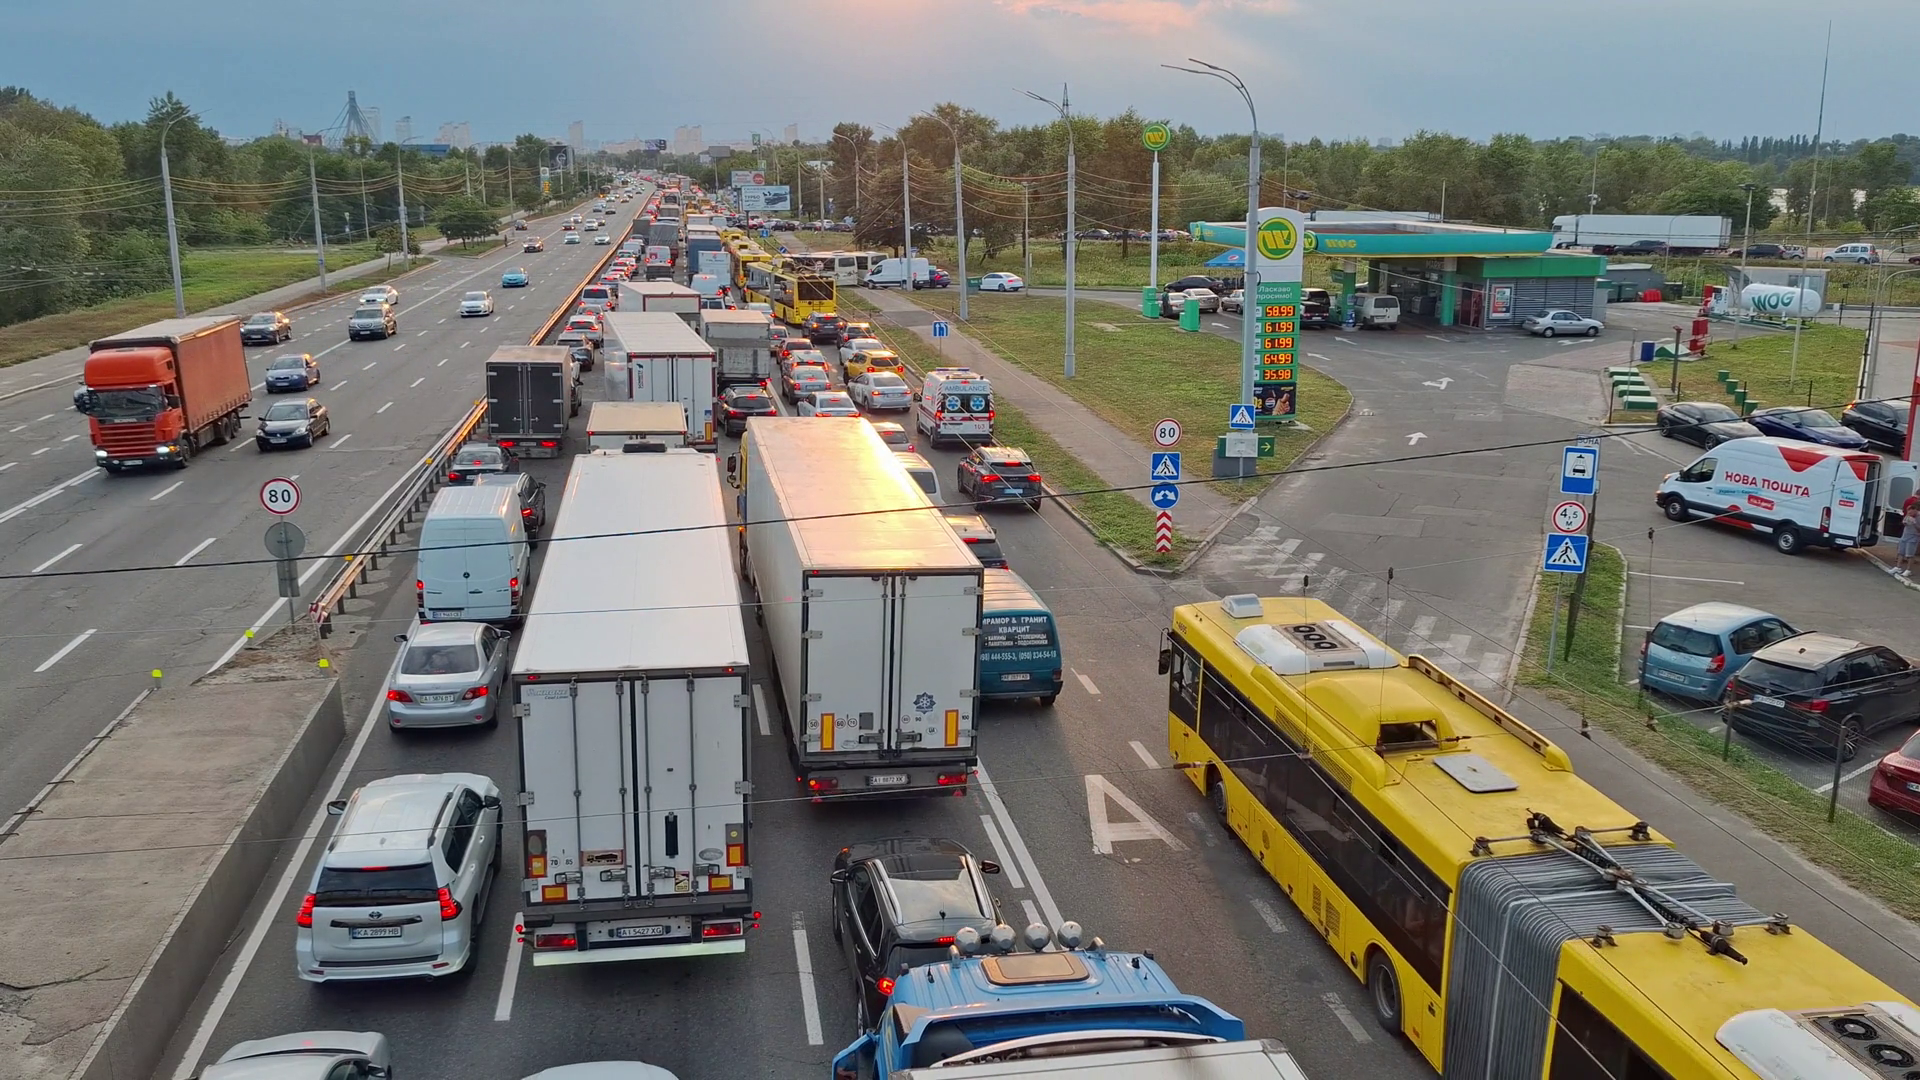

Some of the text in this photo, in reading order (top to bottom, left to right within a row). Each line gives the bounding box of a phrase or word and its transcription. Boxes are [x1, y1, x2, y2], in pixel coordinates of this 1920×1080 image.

[1751, 291, 1796, 311] WOG
[1266, 305, 1294, 317] 58.99
[1265, 322, 1293, 333] 61.99
[1265, 337, 1292, 349] 61.99
[1264, 353, 1292, 365] 64.99
[1264, 369, 1291, 380] 35.98
[1159, 427, 1176, 439] 80
[1725, 471, 1810, 498] НОВА ПОШТА
[268, 489, 291, 503] 80
[1560, 508, 1579, 520] 4,5
[1021, 616, 1048, 624] ГРАНИТ
[999, 626, 1031, 634] КВАРЦИТ
[565, 858, 573, 866] 85
[357, 927, 399, 937] KA 2899 HB
[633, 927, 650, 936] 5427
[650, 926, 662, 935] XG
